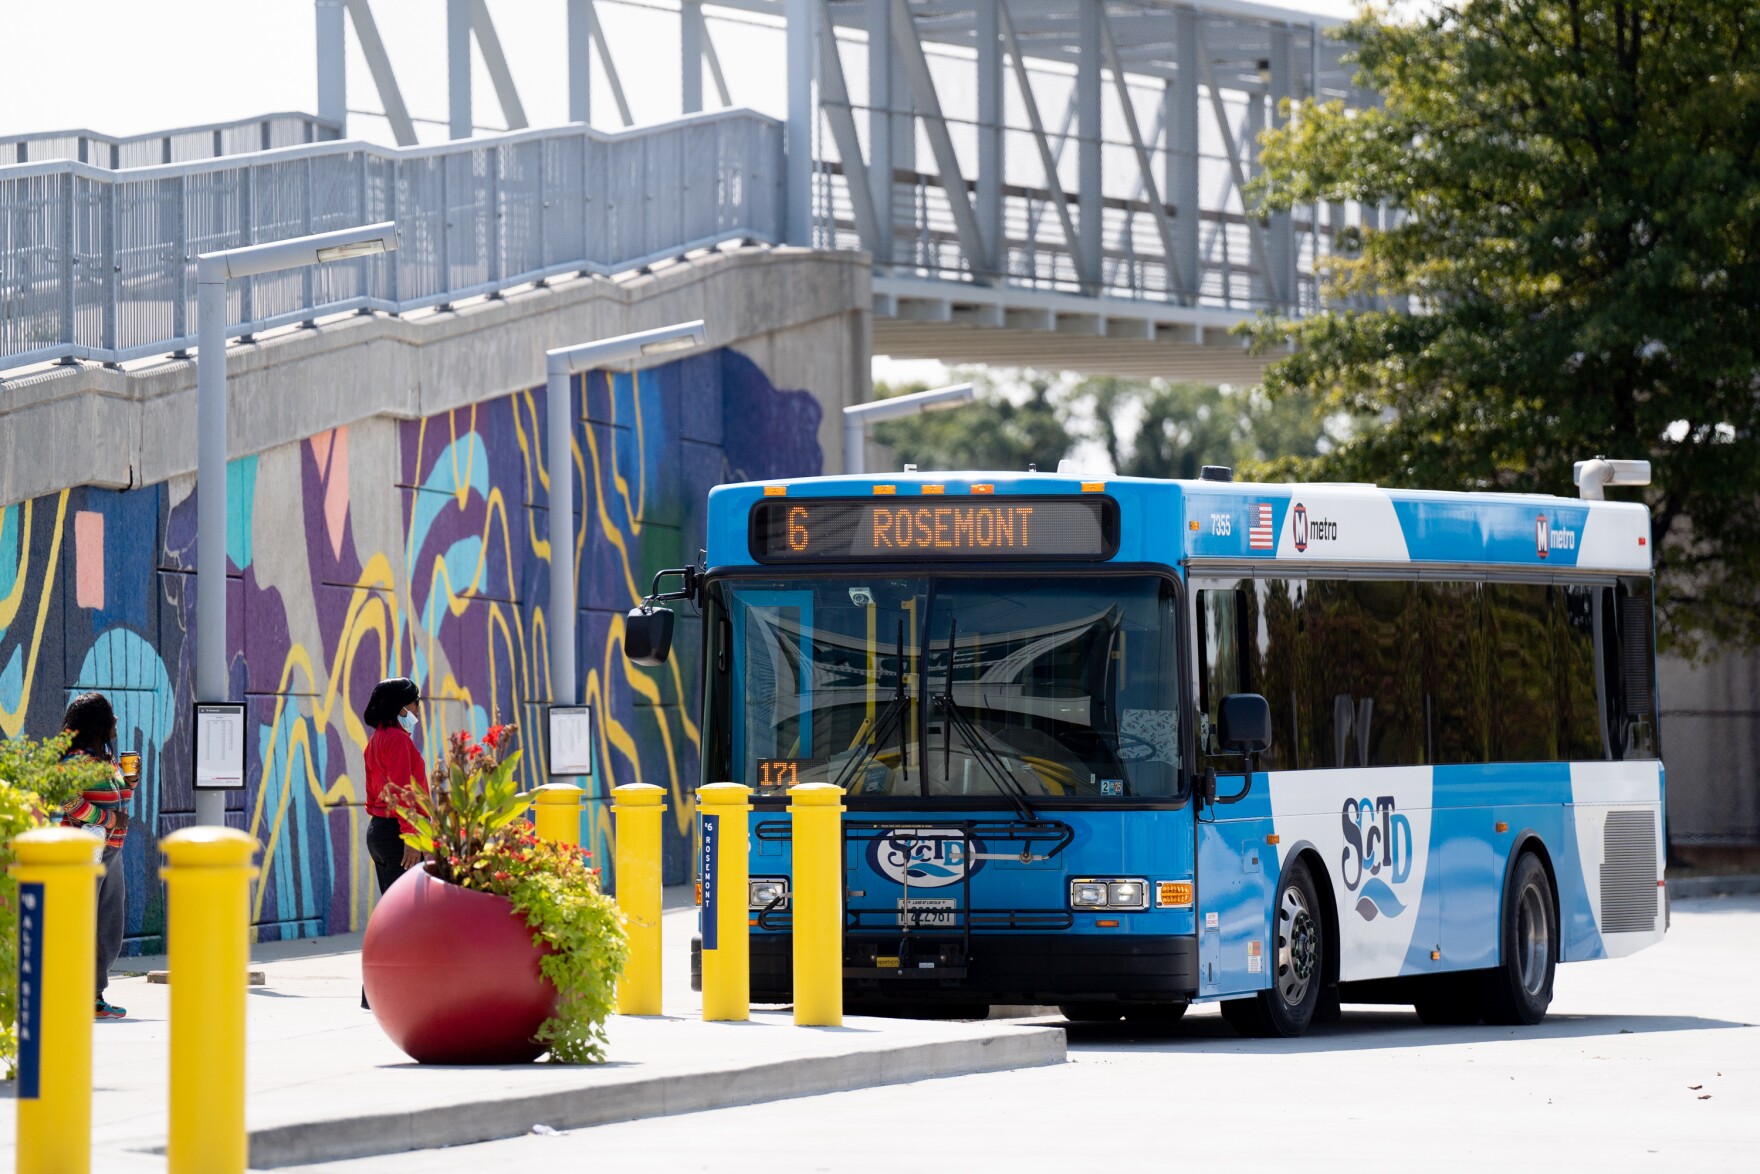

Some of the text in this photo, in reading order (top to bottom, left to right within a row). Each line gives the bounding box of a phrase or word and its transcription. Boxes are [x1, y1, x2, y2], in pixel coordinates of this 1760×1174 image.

[789, 507, 1033, 550] 6 ROSEMONT
[1210, 513, 1231, 537] 7355
[1310, 516, 1337, 541] metro
[1550, 525, 1575, 550] metro
[760, 762, 800, 786] 171
[22, 914, 33, 974] ALTA
